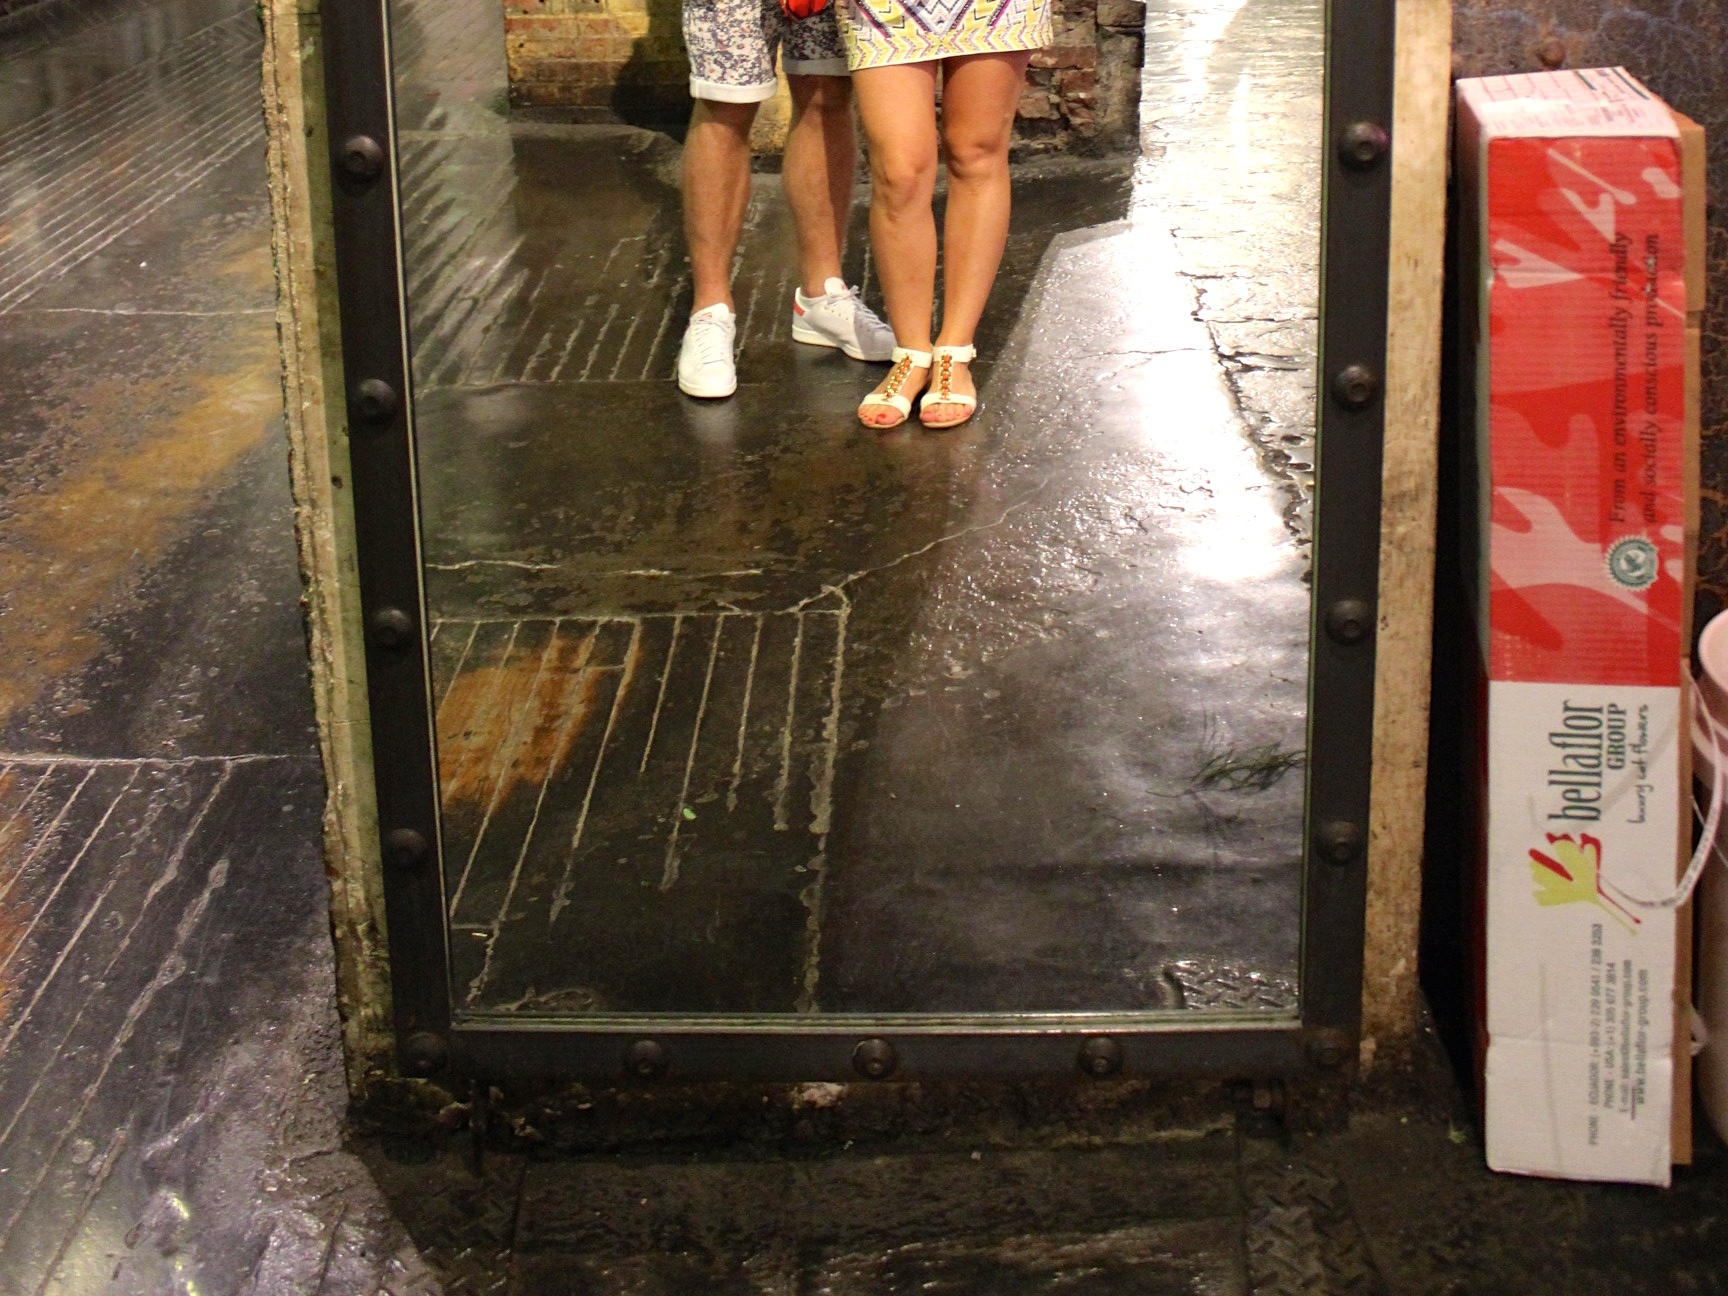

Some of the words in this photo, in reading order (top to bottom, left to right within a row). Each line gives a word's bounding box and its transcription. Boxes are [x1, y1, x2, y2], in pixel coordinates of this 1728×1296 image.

[1608, 232, 1632, 302] friendly
[1641, 234, 1664, 328] production
[1610, 306, 1632, 446] environmentally
[1640, 332, 1658, 415] conscious
[1613, 451, 1626, 473] an
[1639, 421, 1660, 487] socially
[1608, 479, 1628, 523] From
[1639, 492, 1657, 523] and
[1607, 703, 1626, 770] GROUP
[1628, 704, 1649, 755] flowers
[1548, 699, 1603, 821] bellaflor
[1631, 757, 1647, 780] cut
[1626, 784, 1654, 824] luxury
[1603, 1079, 1614, 1109] PHONE
[1588, 1116, 1599, 1146] PHONE
